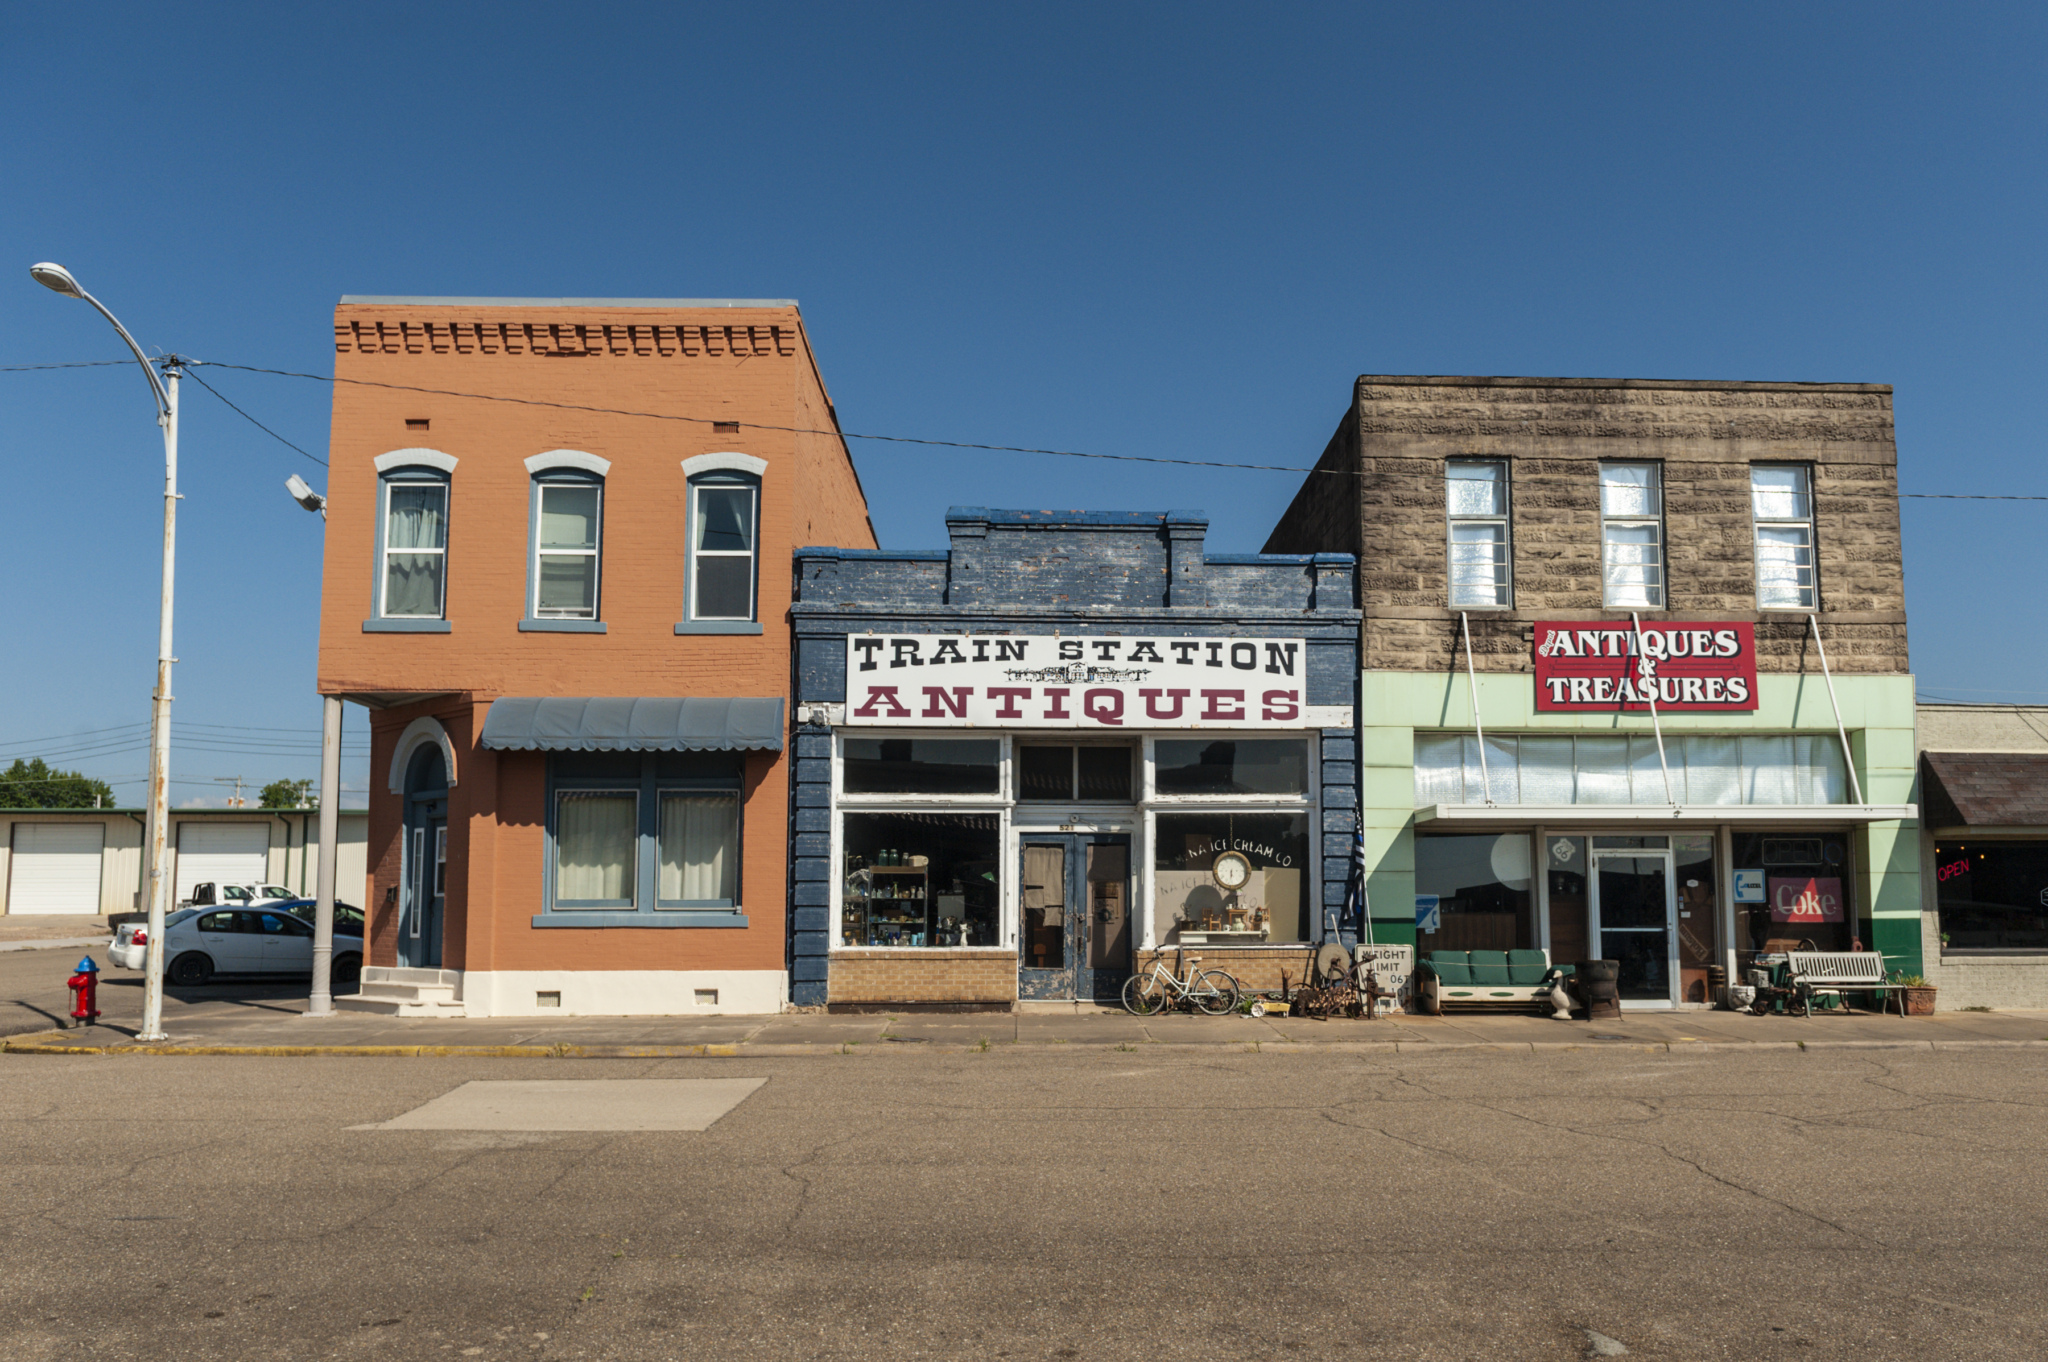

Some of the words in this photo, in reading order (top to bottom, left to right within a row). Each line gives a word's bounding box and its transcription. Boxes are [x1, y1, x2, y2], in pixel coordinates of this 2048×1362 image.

[854, 639, 1029, 671] TRAIN
[1059, 640, 1299, 676] STATION
[1550, 630, 1741, 661] ANTIQUES
[1637, 658, 1657, 676] &
[1546, 676, 1750, 704] TREASURES
[854, 686, 1299, 725] ANTIQUES
[1276, 852, 1291, 867] CO
[1555, 845, 1569, 859] 66
[1765, 841, 1821, 862] OPEN
[1938, 859, 1969, 881] OPEN
[1776, 885, 1836, 915] Coke
